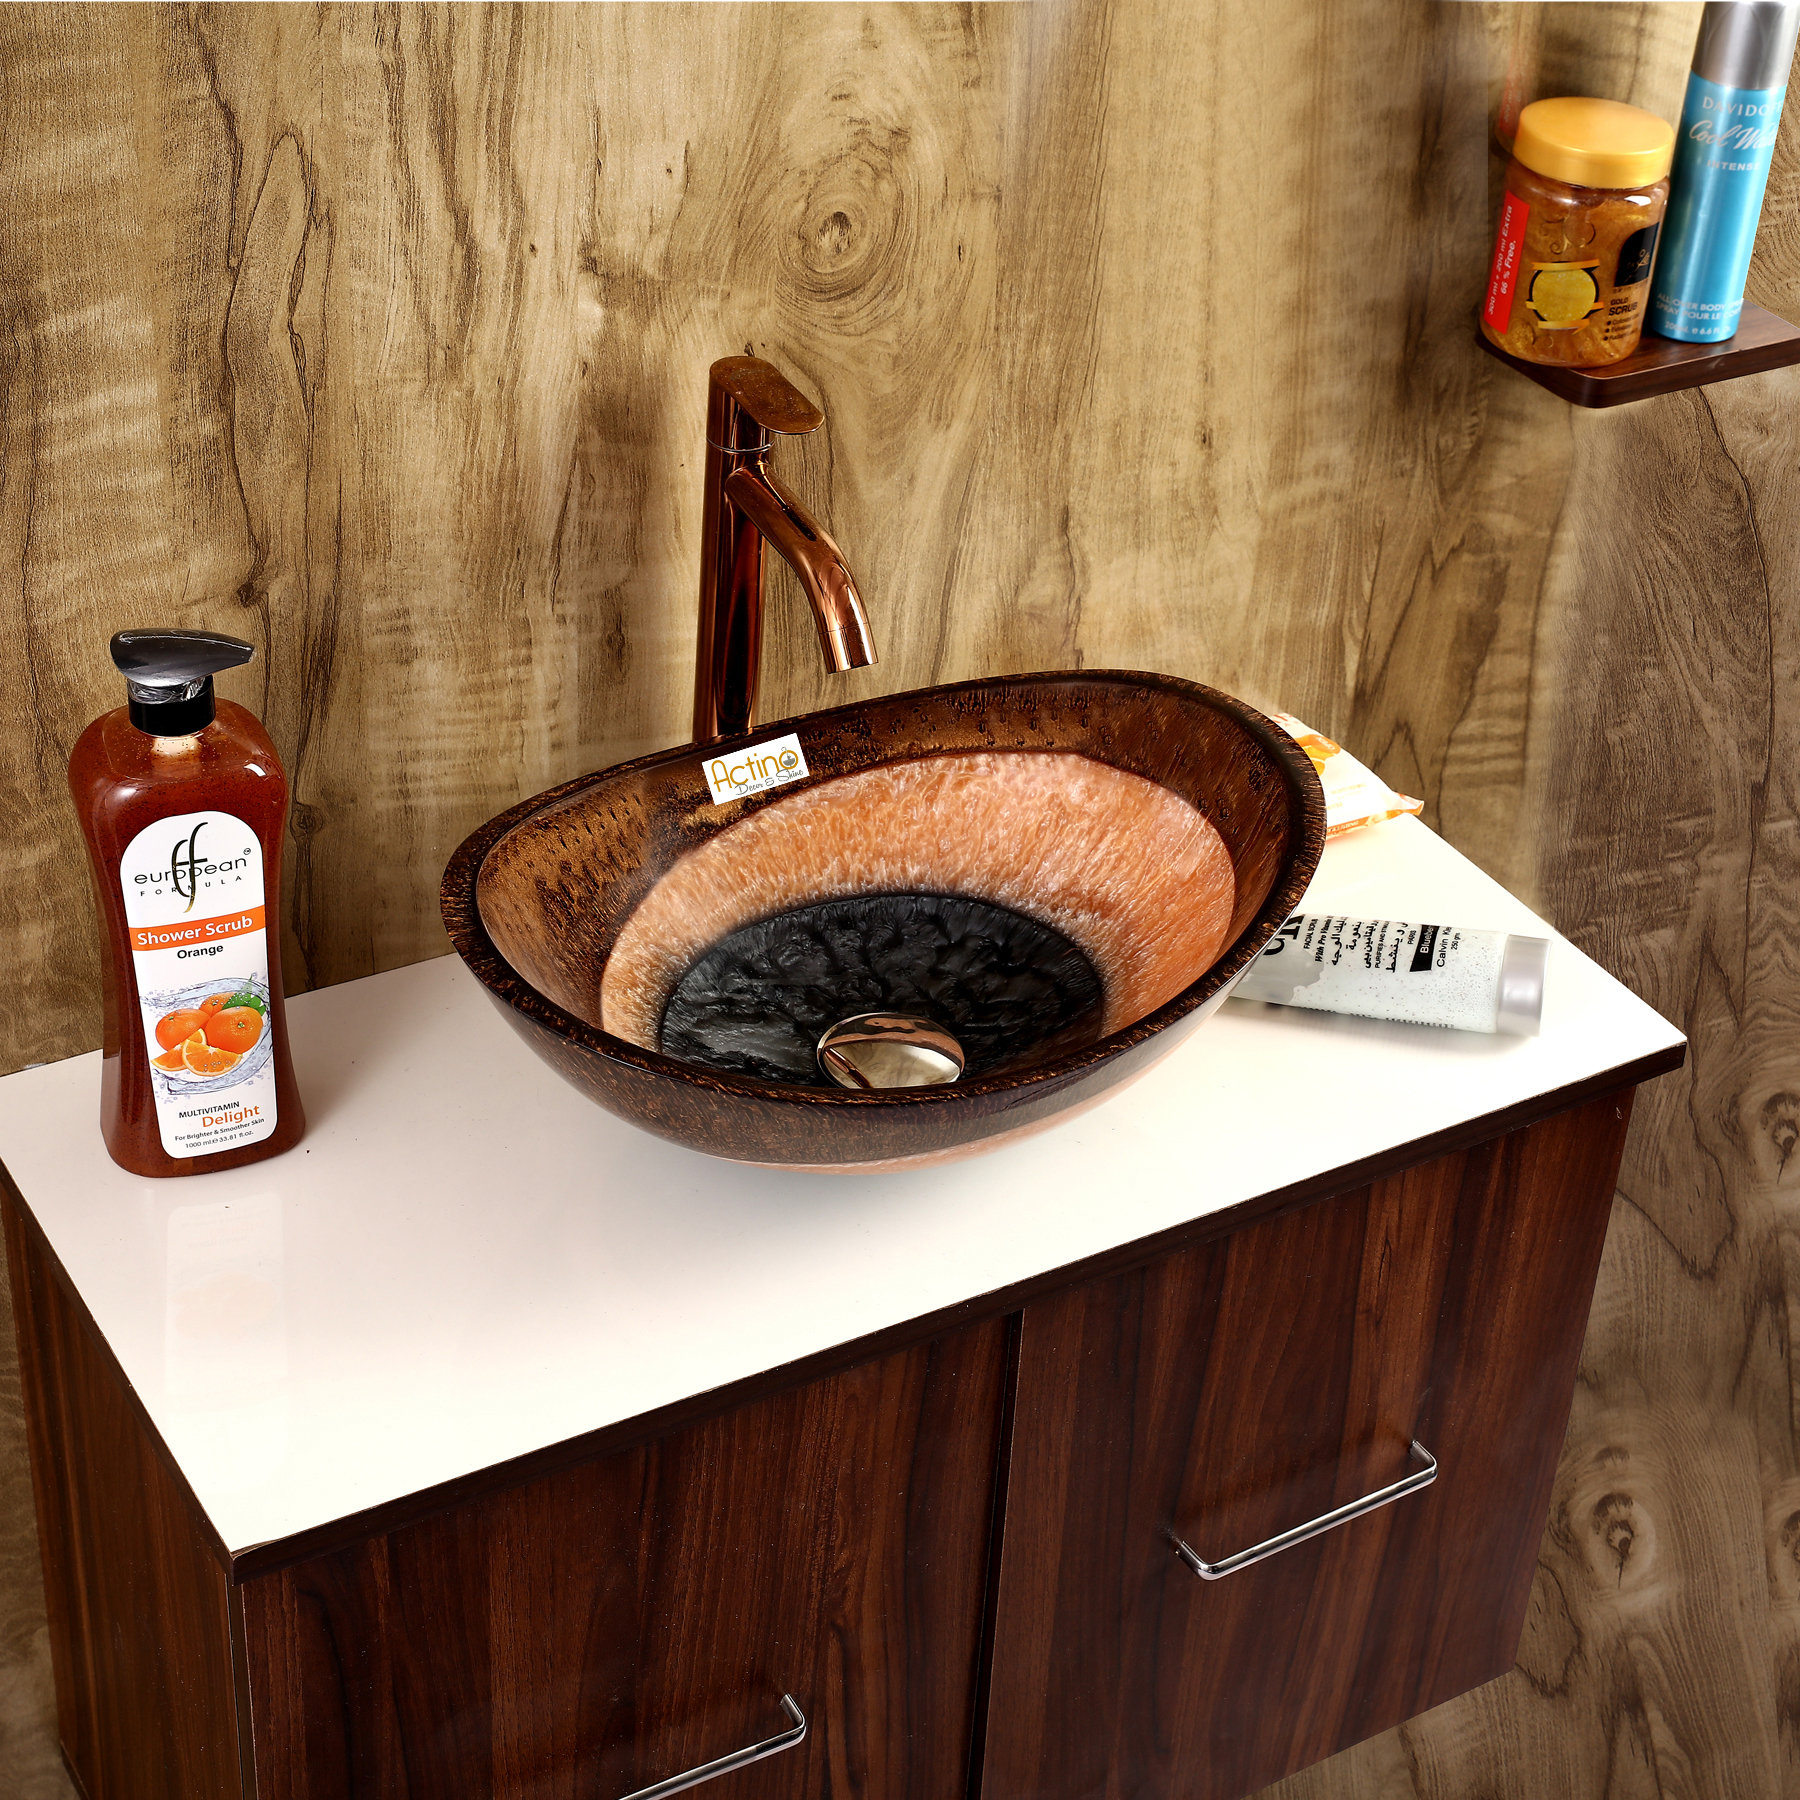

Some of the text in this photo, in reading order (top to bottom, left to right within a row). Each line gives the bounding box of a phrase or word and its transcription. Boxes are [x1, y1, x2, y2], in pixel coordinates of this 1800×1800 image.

[1689, 120, 1743, 147] Cool
[1496, 253, 1504, 272] 200
[1502, 204, 1513, 237] Extra
[1500, 281, 1508, 295] 66
[1608, 301, 1639, 316] SCRUB
[1610, 297, 1629, 305] GOLD
[1700, 303, 1726, 312] BODY
[1682, 310, 1710, 320] POUR
[1711, 313, 1721, 321] LE
[137, 916, 253, 946] Shower Scrub
[1318, 934, 1327, 945] Pro
[1407, 930, 1417, 945] PARIS
[1303, 931, 1314, 950] FACIAL
[177, 945, 224, 960] Orange
[1315, 945, 1325, 963] With
[1375, 943, 1384, 969] PURIFIES
[1436, 938, 1449, 967] Calvin
[178, 1101, 240, 1118] MULTIVITAMIN
[202, 1105, 260, 1128] Delight
[186, 1130, 213, 1141] Brighter
[219, 1122, 250, 1134] Smoother
[251, 1117, 265, 1126] Skin
